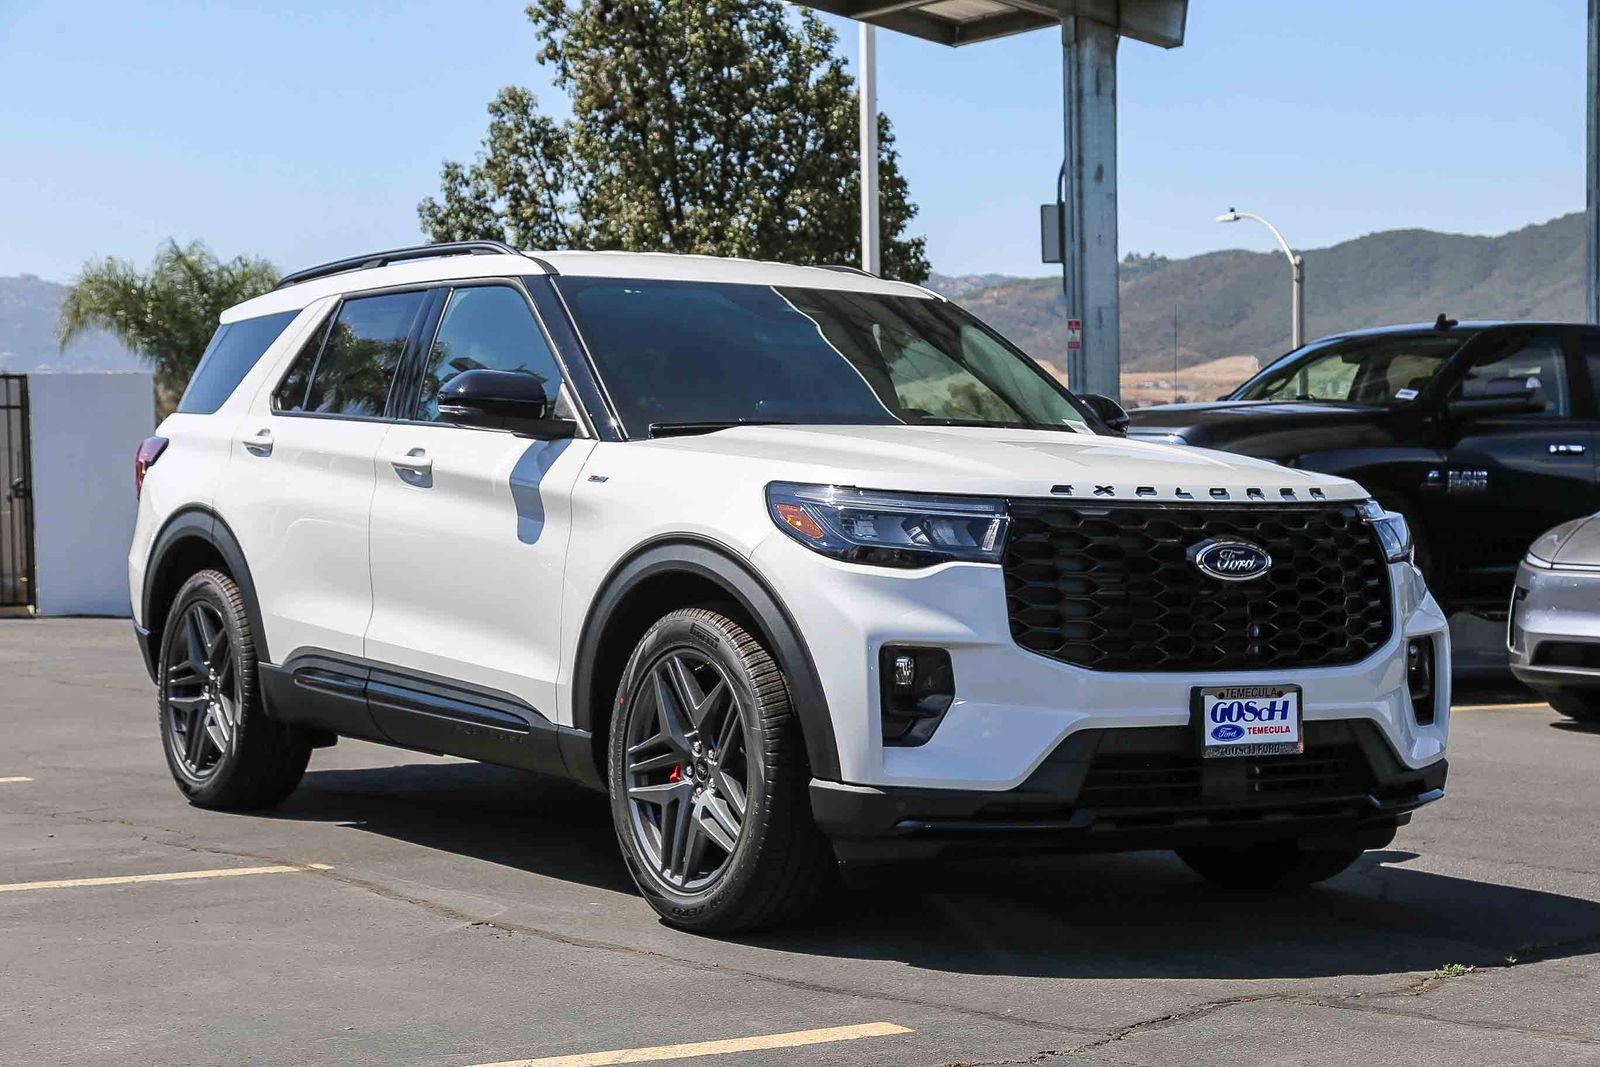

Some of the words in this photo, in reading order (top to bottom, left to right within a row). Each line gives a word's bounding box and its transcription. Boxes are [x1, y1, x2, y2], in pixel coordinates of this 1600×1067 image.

[1050, 484, 1326, 500] EXPLORER
[1216, 549, 1257, 572] Ford
[1225, 688, 1277, 699] TEMECULA
[1218, 727, 1238, 738] Ford
[1247, 725, 1291, 735] TEMECULA
[1258, 742, 1281, 755] FORD
